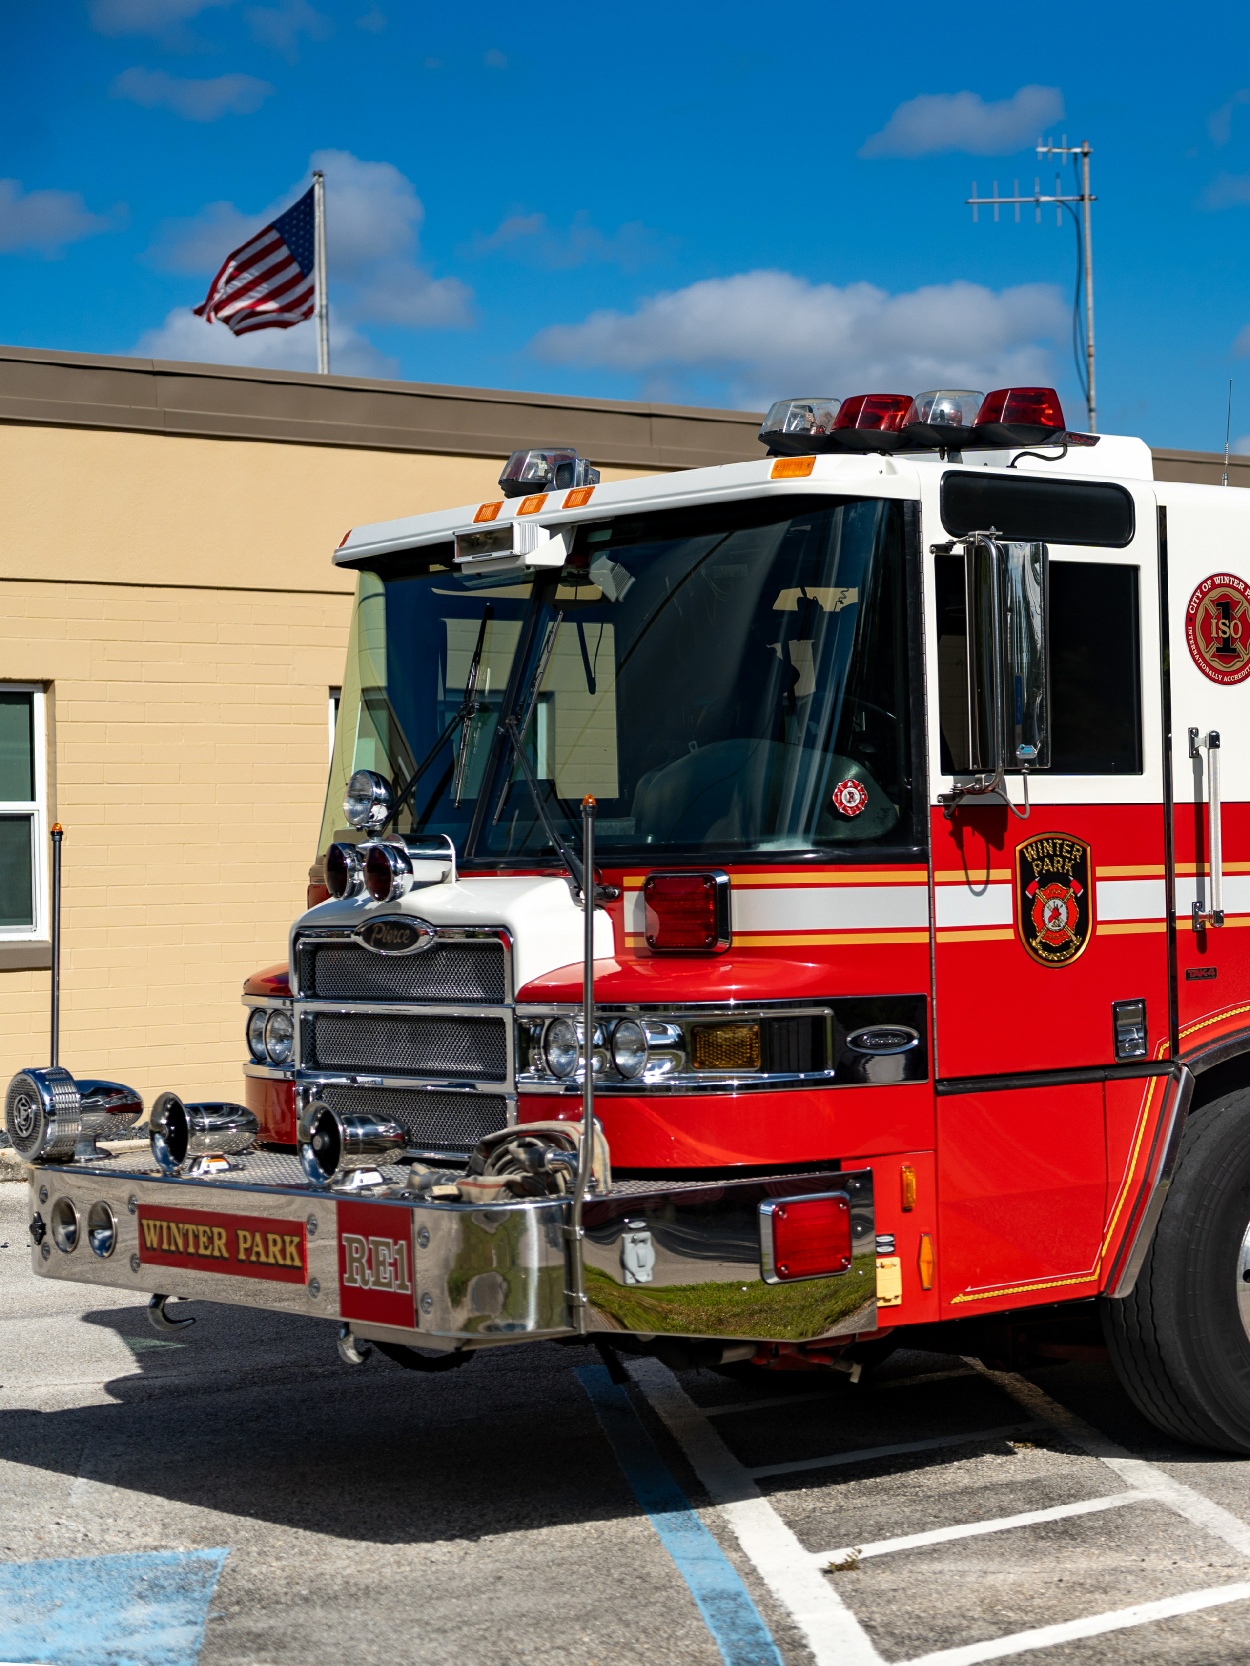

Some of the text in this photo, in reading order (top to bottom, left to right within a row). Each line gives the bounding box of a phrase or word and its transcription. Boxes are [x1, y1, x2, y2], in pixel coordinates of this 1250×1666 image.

[1188, 590, 1203, 614] CITY
[1201, 579, 1212, 592] OF
[1213, 576, 1245, 592] WINTER
[1210, 619, 1243, 639] ISO
[1215, 601, 1238, 655] 1
[1188, 626, 1223, 681] INTERNATIONALLY
[1022, 839, 1083, 863] WINTER
[1031, 857, 1075, 877] PARK
[370, 923, 410, 946] Pierce
[141, 1218, 302, 1268] WINTER PARK
[342, 1233, 412, 1295] RE1
